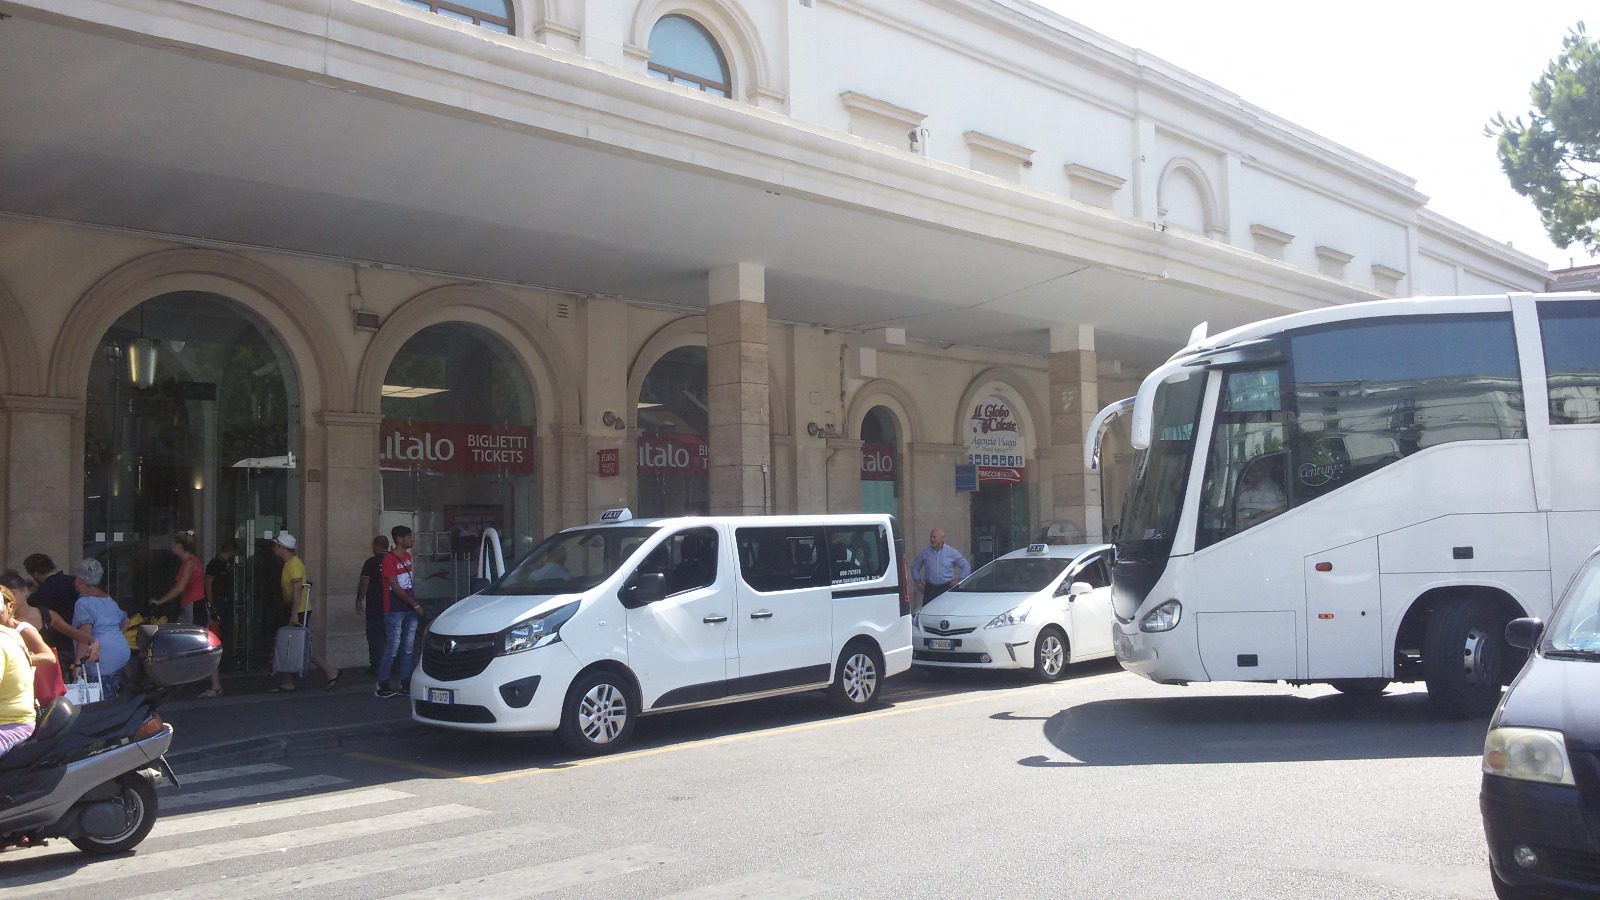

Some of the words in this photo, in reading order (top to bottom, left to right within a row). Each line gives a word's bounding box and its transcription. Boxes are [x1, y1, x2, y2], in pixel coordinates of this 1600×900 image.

[985, 404, 1009, 418] Globo
[990, 418, 1017, 432] Celeste
[386, 431, 455, 461] italo
[467, 434, 527, 449] BIGLIETTI
[971, 437, 996, 449] Agenzia
[998, 438, 1017, 451] Viaggi
[472, 449, 524, 463] TICKETS
[639, 442, 690, 468] italo
[861, 451, 893, 472] talo
[604, 511, 621, 519] TAXI
